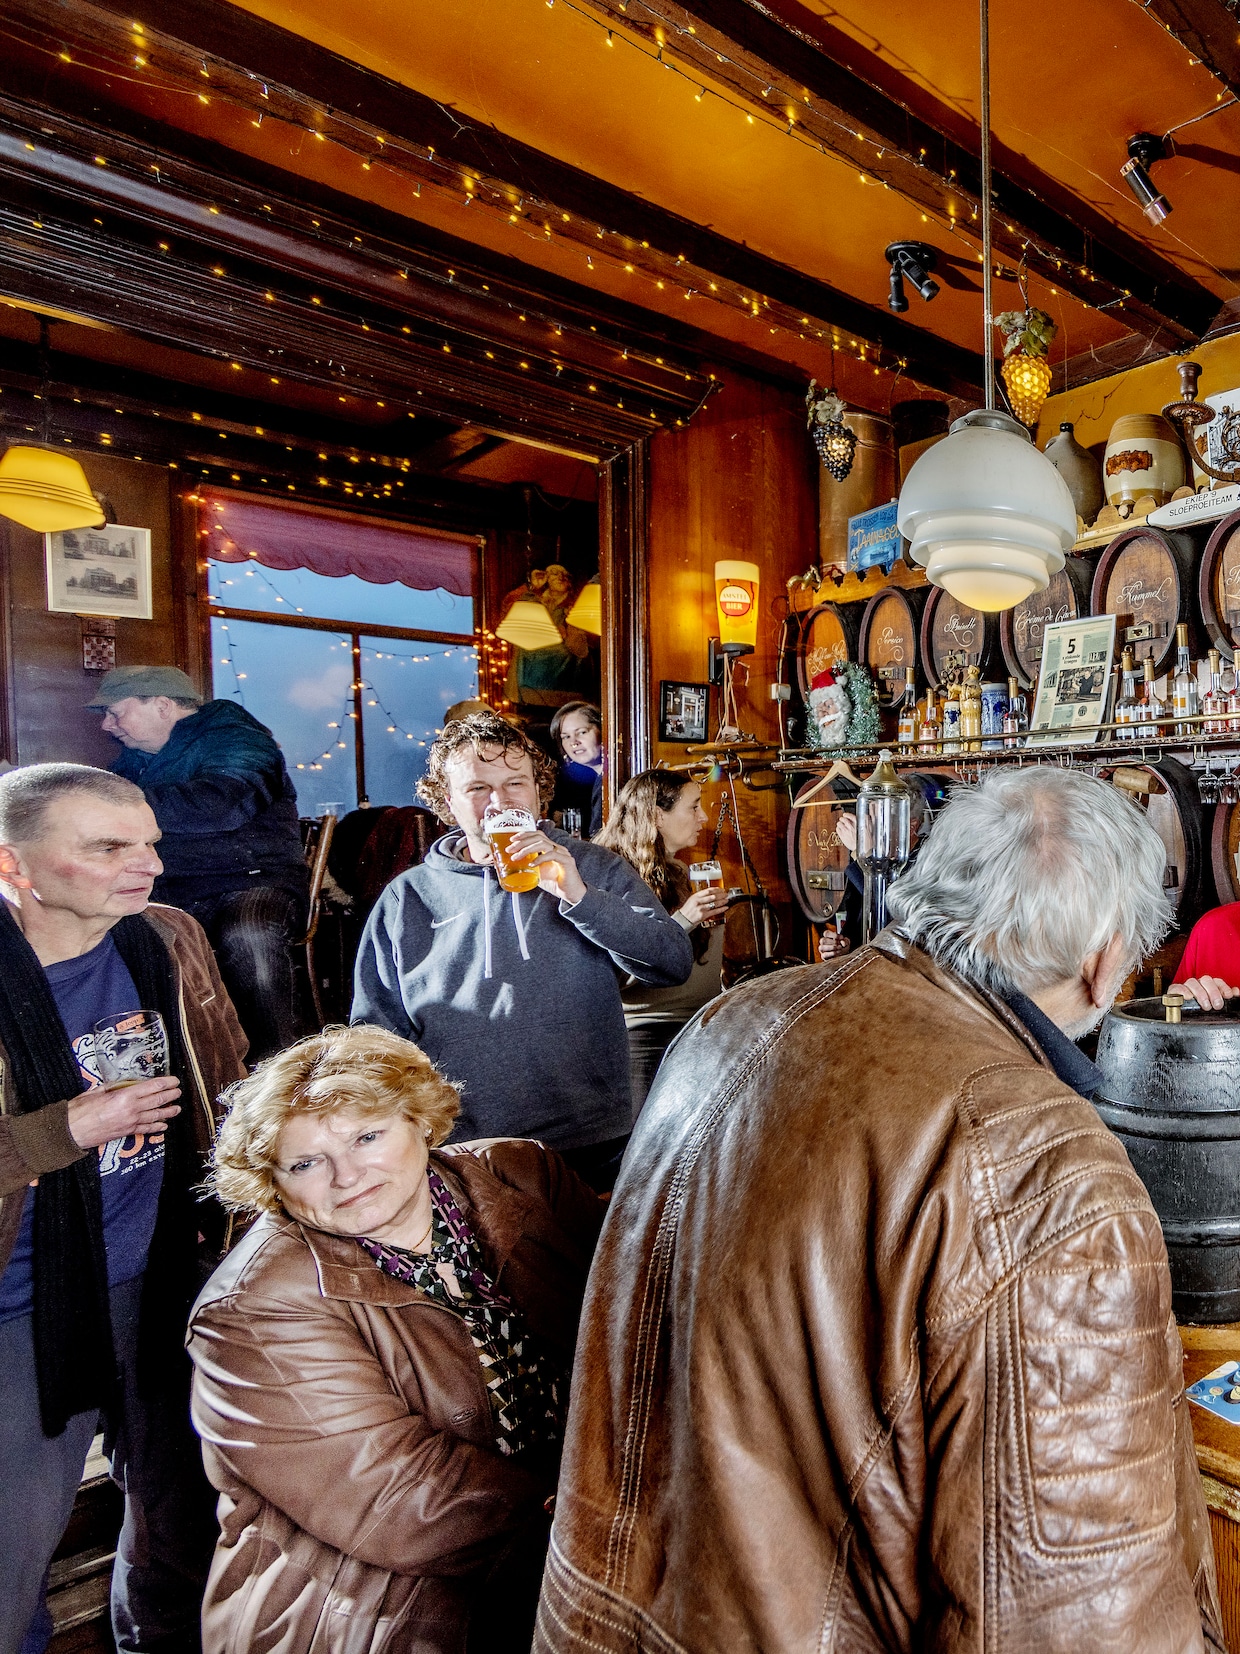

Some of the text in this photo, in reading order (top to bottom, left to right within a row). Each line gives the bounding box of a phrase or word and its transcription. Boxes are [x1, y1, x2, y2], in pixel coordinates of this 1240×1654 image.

[1168, 494, 1233, 517] SLOEPROEITEAM
[726, 602, 743, 611] BIER
[1067, 638, 1077, 654] 5
[1066, 704, 1075, 719] 3
[135, 1161, 147, 1169] km
